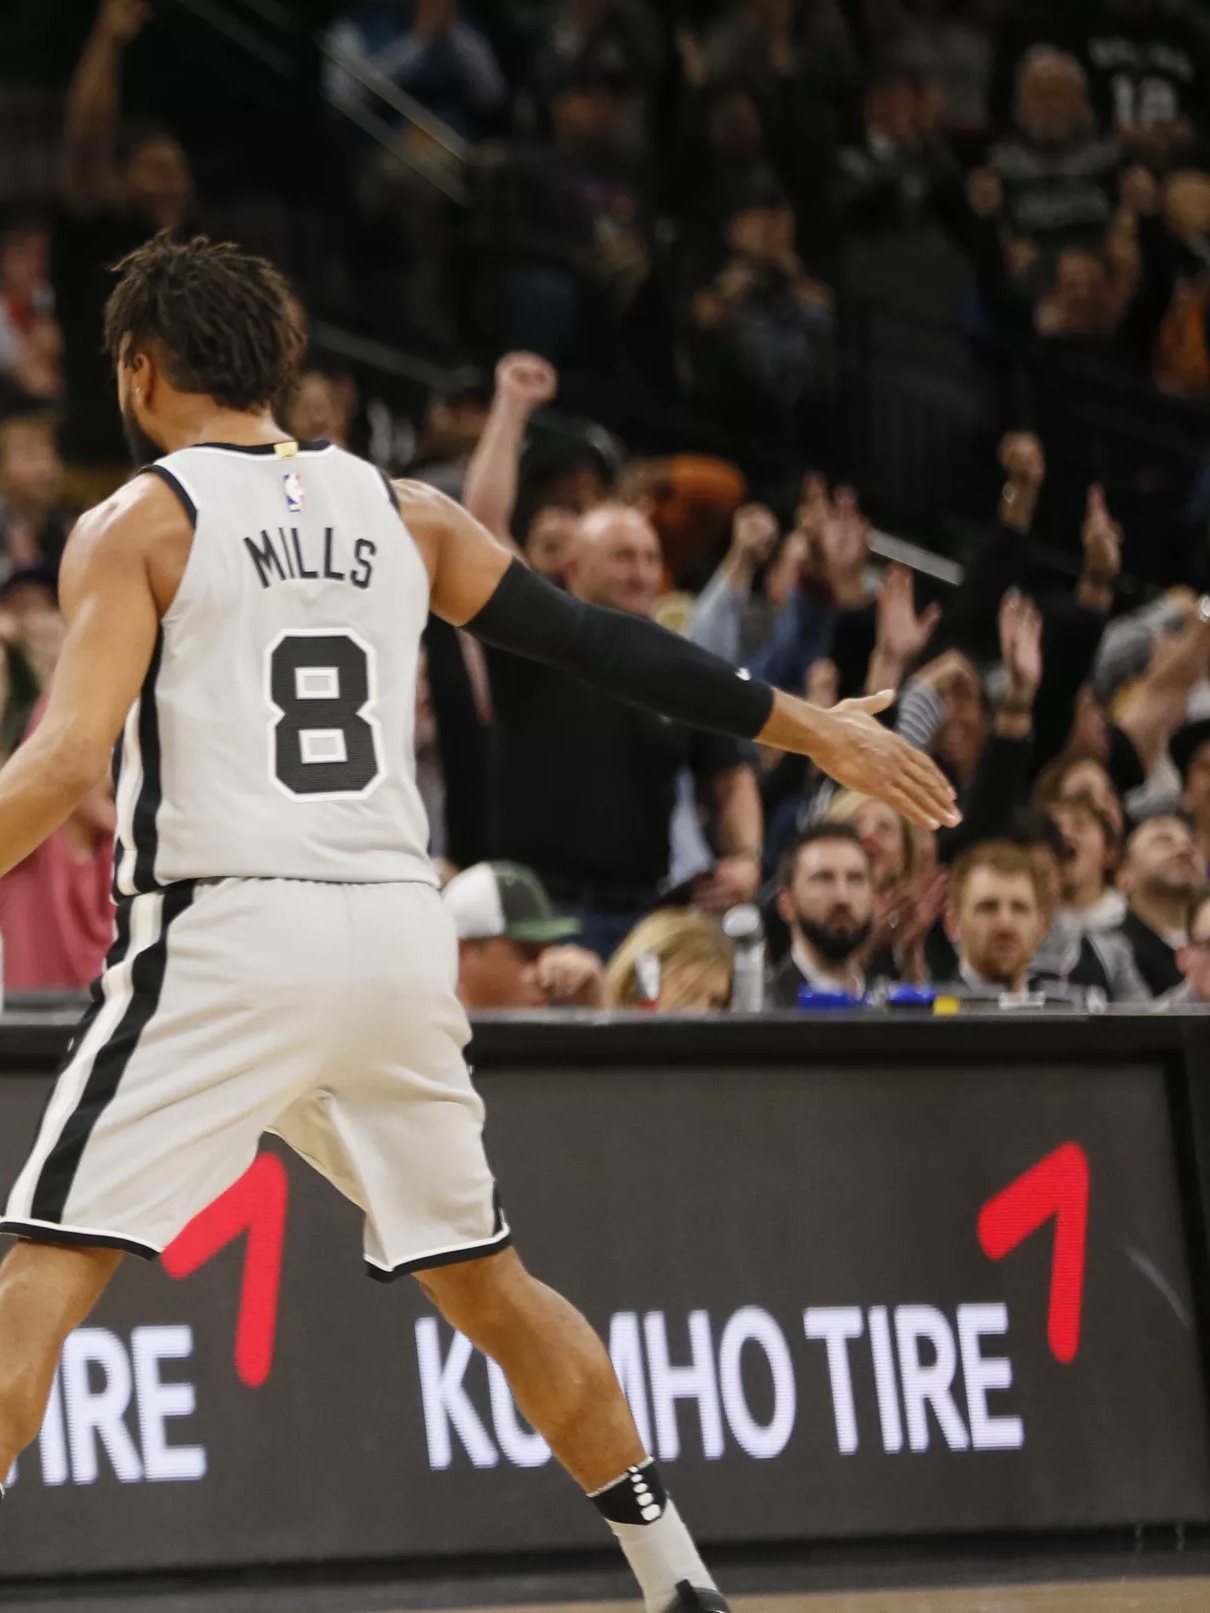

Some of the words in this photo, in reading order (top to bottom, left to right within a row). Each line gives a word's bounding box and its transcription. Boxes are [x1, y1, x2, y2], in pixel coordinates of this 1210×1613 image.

[243, 527, 378, 590] MILLS
[265, 628, 386, 802] 8
[803, 1303, 1024, 1454] TIRE
